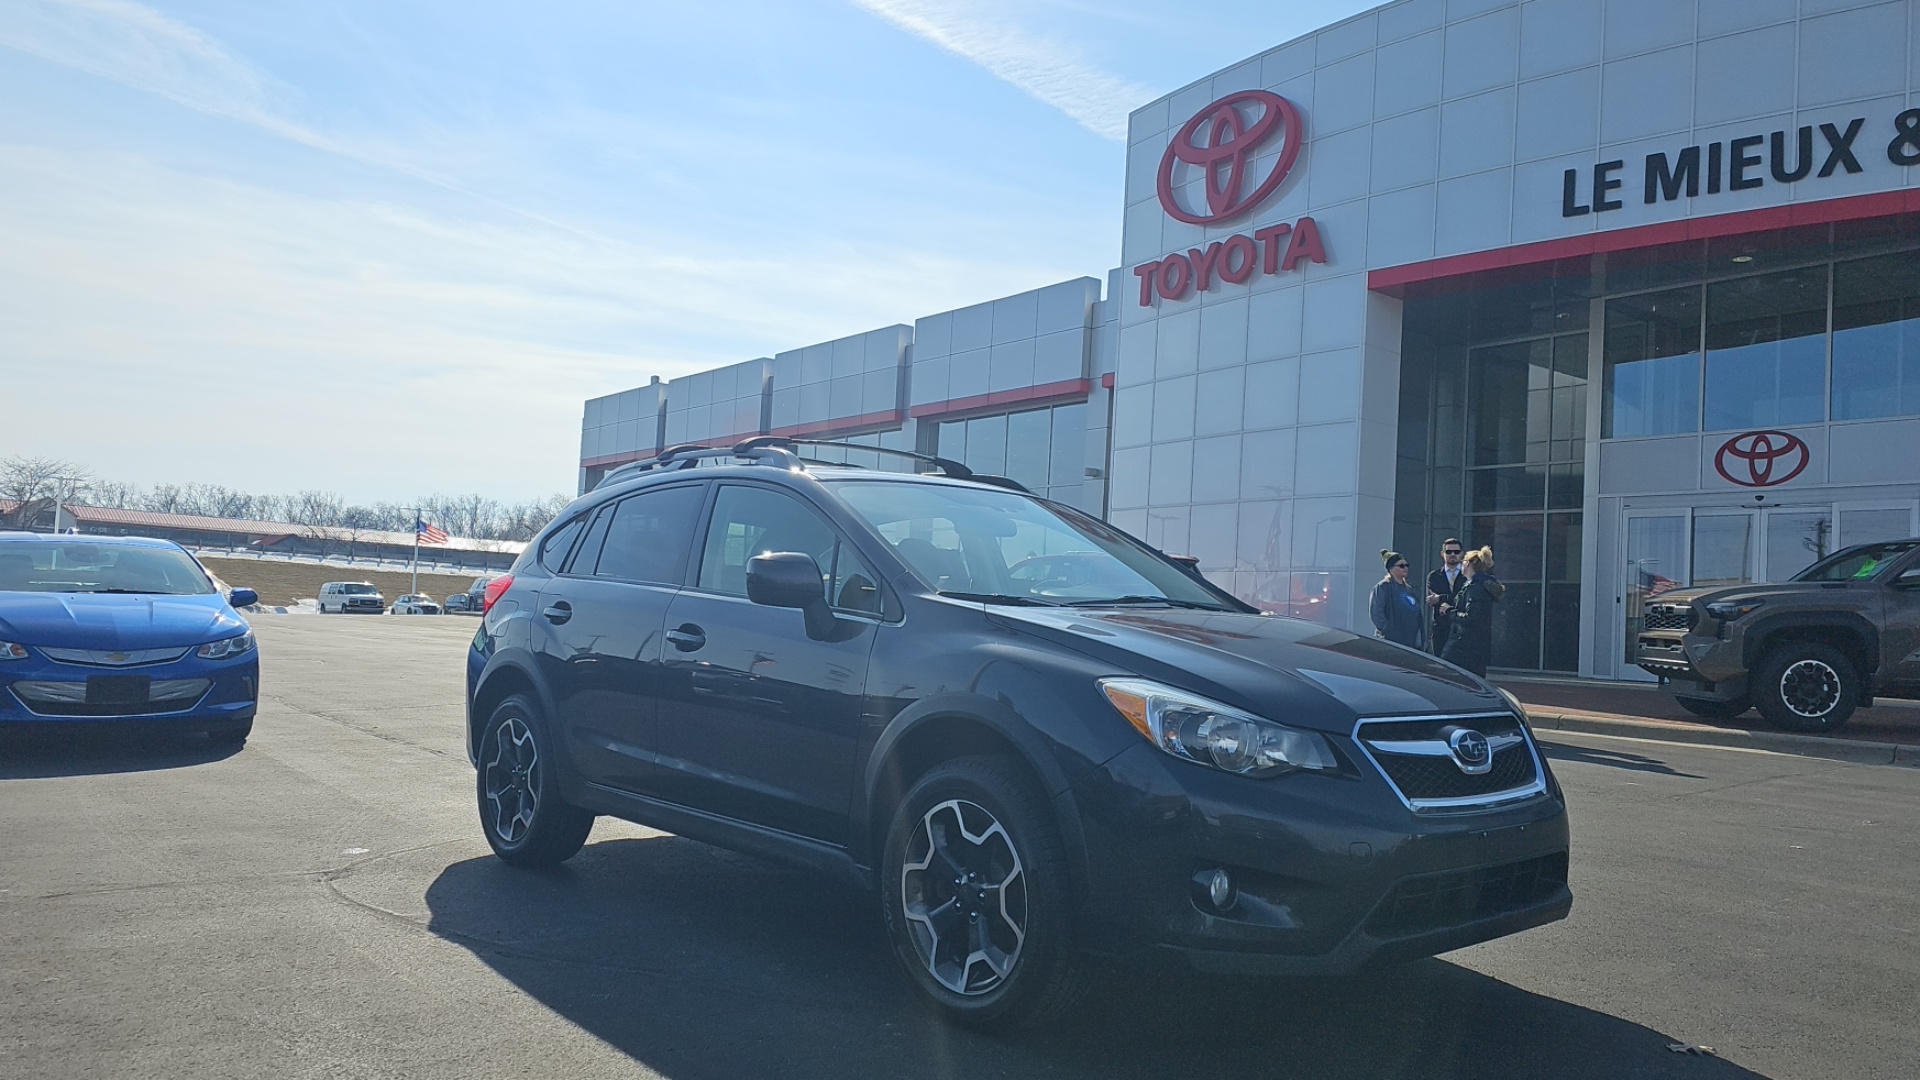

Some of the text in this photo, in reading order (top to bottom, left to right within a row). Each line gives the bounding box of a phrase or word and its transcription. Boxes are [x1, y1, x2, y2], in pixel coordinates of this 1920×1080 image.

[1562, 108, 1920, 218] LE MIEUX &
[1134, 217, 1328, 308] TOYOTA
